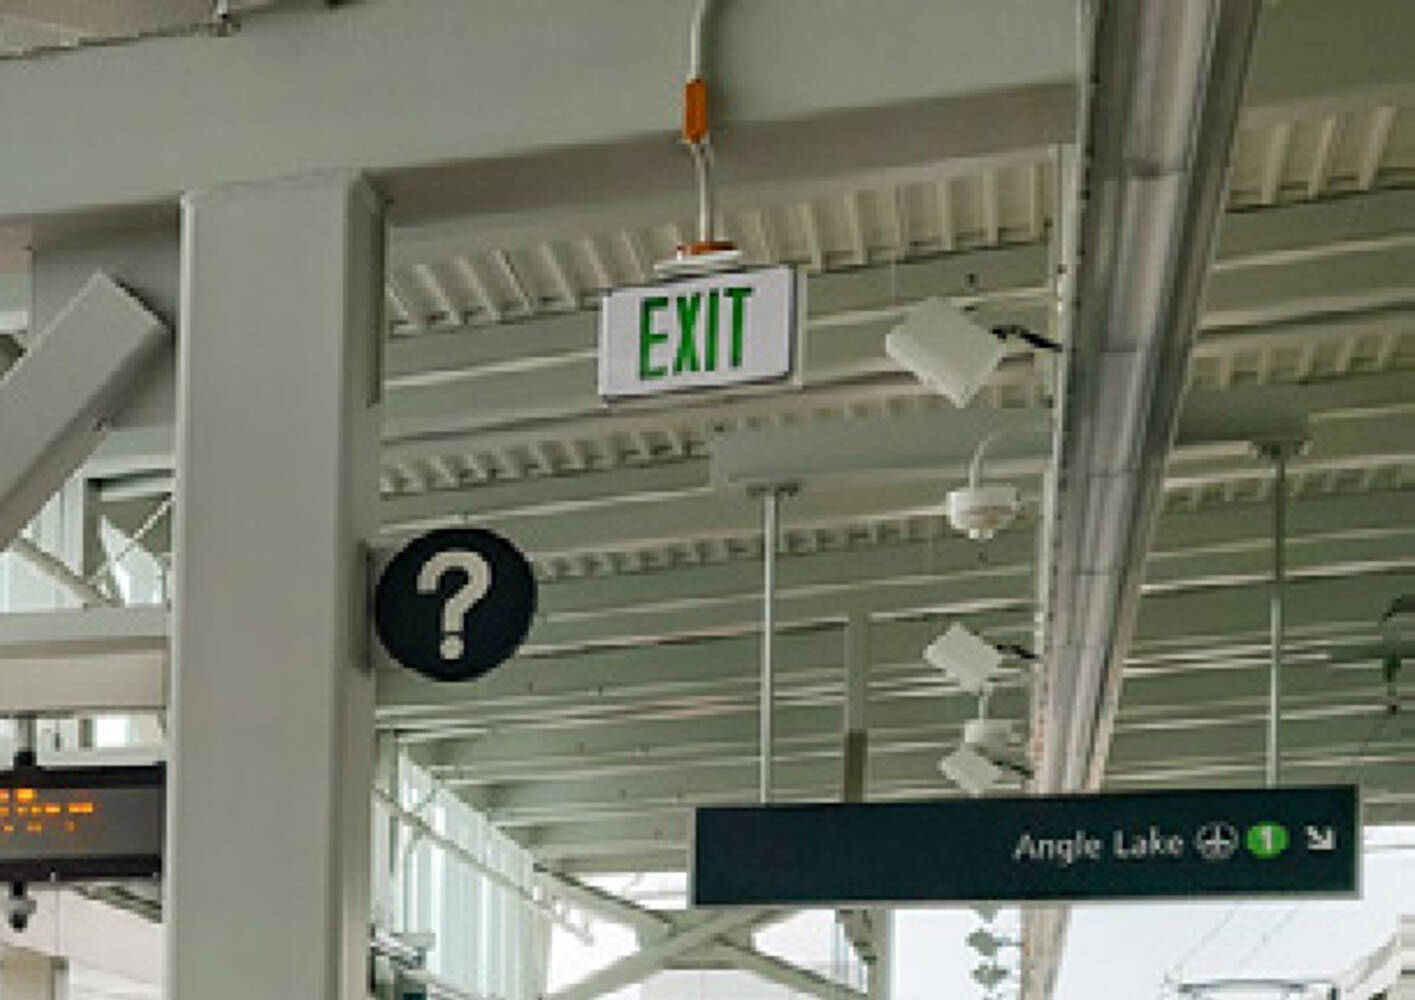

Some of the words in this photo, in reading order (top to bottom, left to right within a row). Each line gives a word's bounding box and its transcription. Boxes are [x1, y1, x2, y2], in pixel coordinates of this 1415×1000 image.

[638, 285, 755, 381] EXIT
[1011, 828, 1104, 867] Angle
[1112, 825, 1184, 860] Lake
